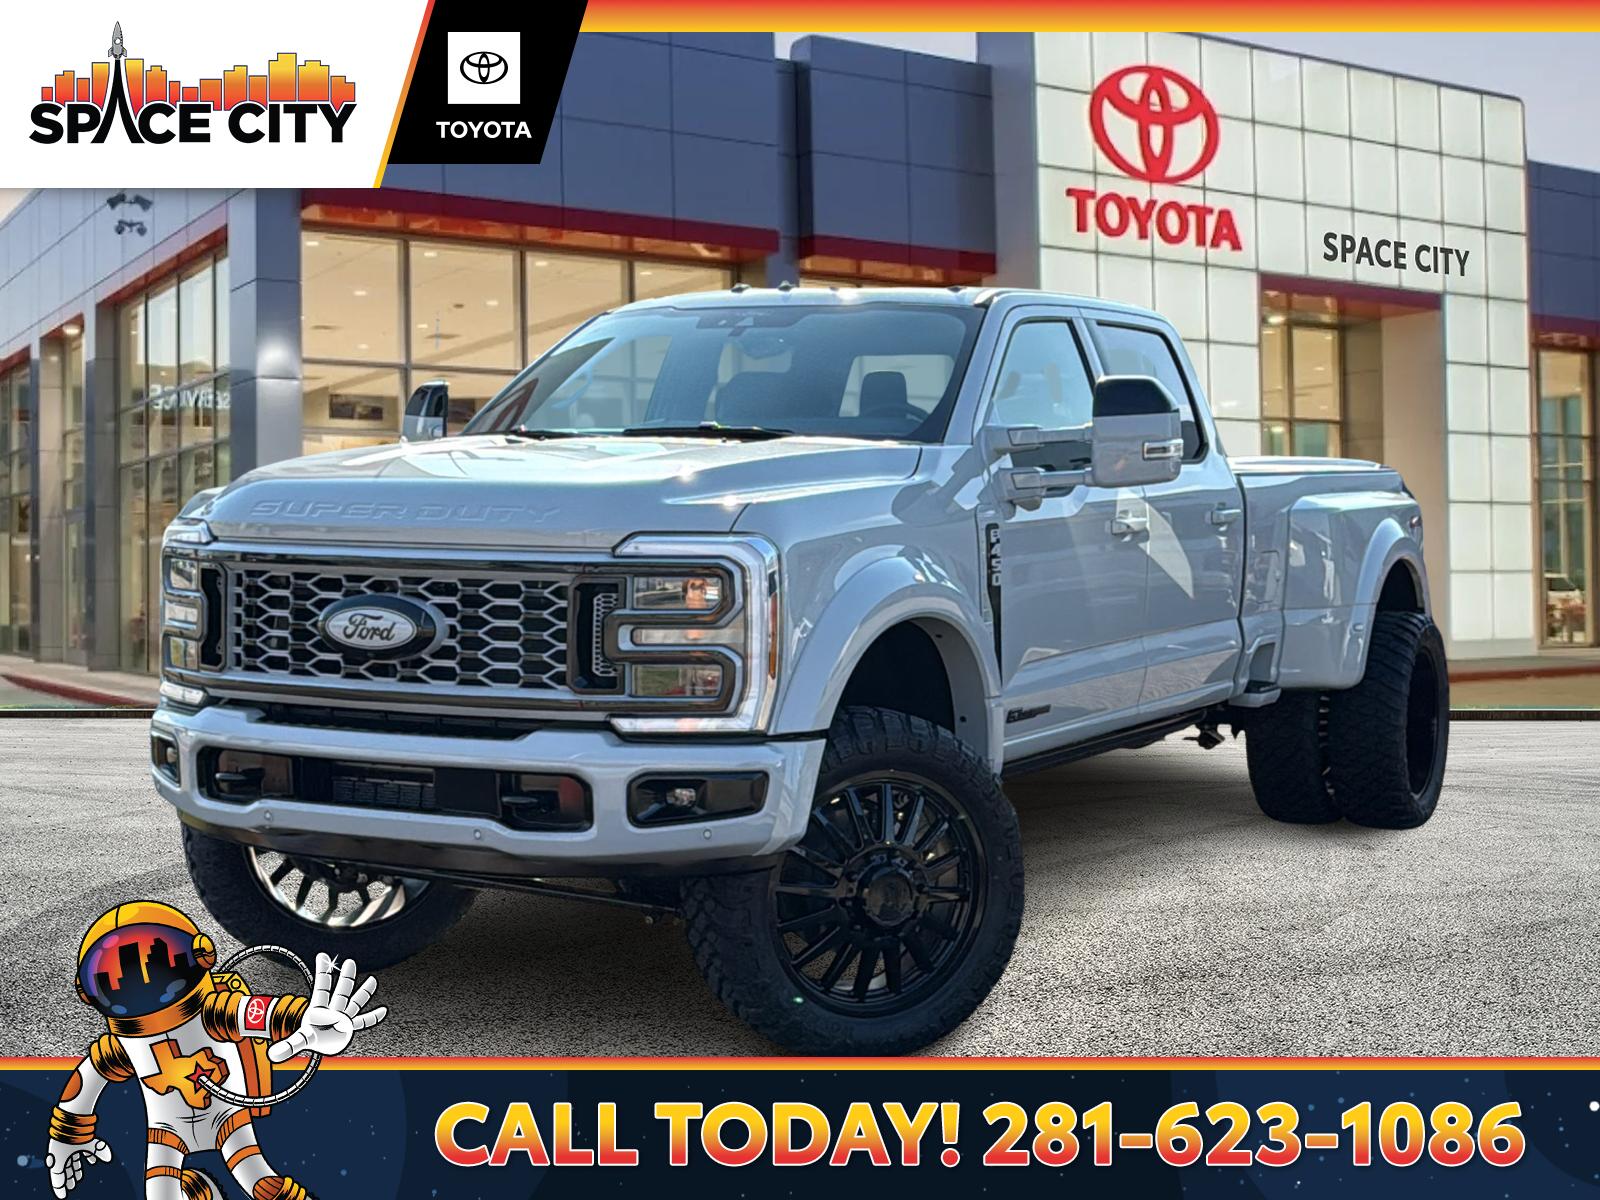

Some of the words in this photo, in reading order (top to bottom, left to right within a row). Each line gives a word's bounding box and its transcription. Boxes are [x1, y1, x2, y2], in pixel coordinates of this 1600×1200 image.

[1066, 188, 1242, 251] TOYOTA
[1323, 232, 1407, 270] SPACE
[1414, 244, 1470, 276] CITY
[250, 500, 408, 520] SUPER
[415, 504, 561, 524] DUTY
[343, 612, 396, 641] Ford
